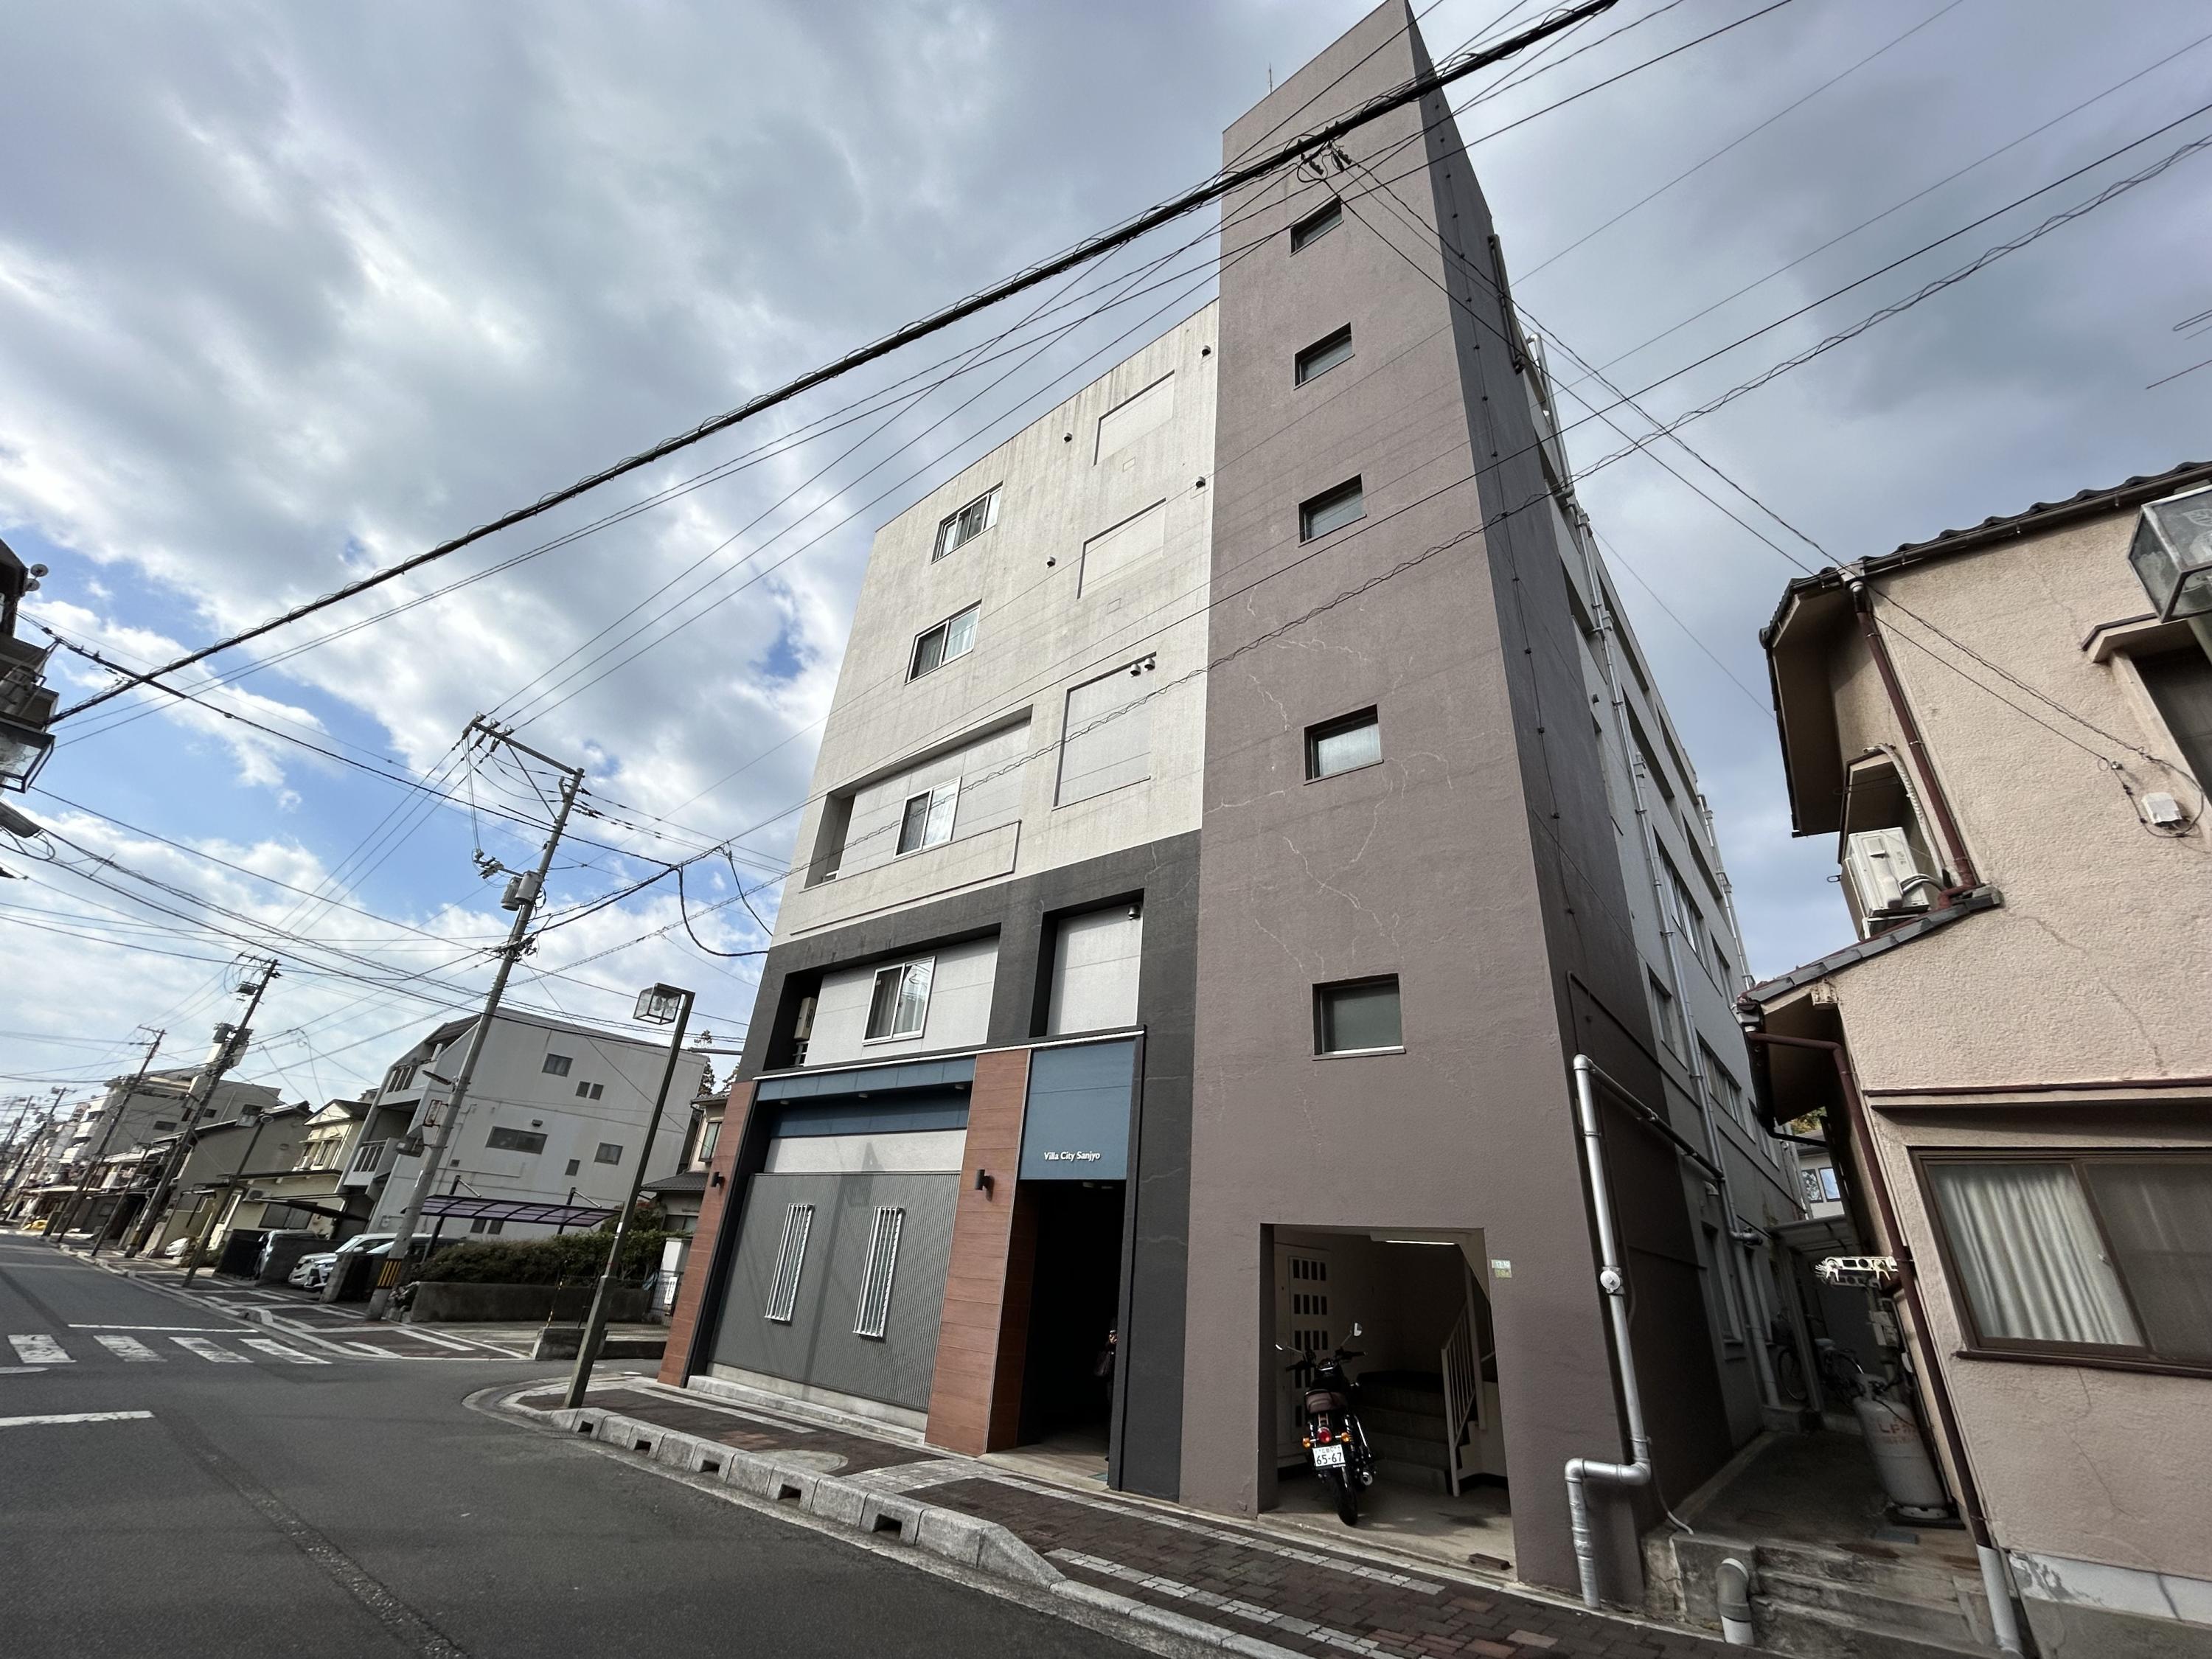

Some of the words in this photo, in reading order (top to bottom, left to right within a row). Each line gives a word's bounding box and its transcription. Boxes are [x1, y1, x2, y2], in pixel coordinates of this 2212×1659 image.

[1043, 1152, 1059, 1161] Villa
[1060, 1151, 1075, 1161] City
[1077, 1151, 1101, 1161] Sanjyo
[1316, 1452, 1342, 1465] 65-67
